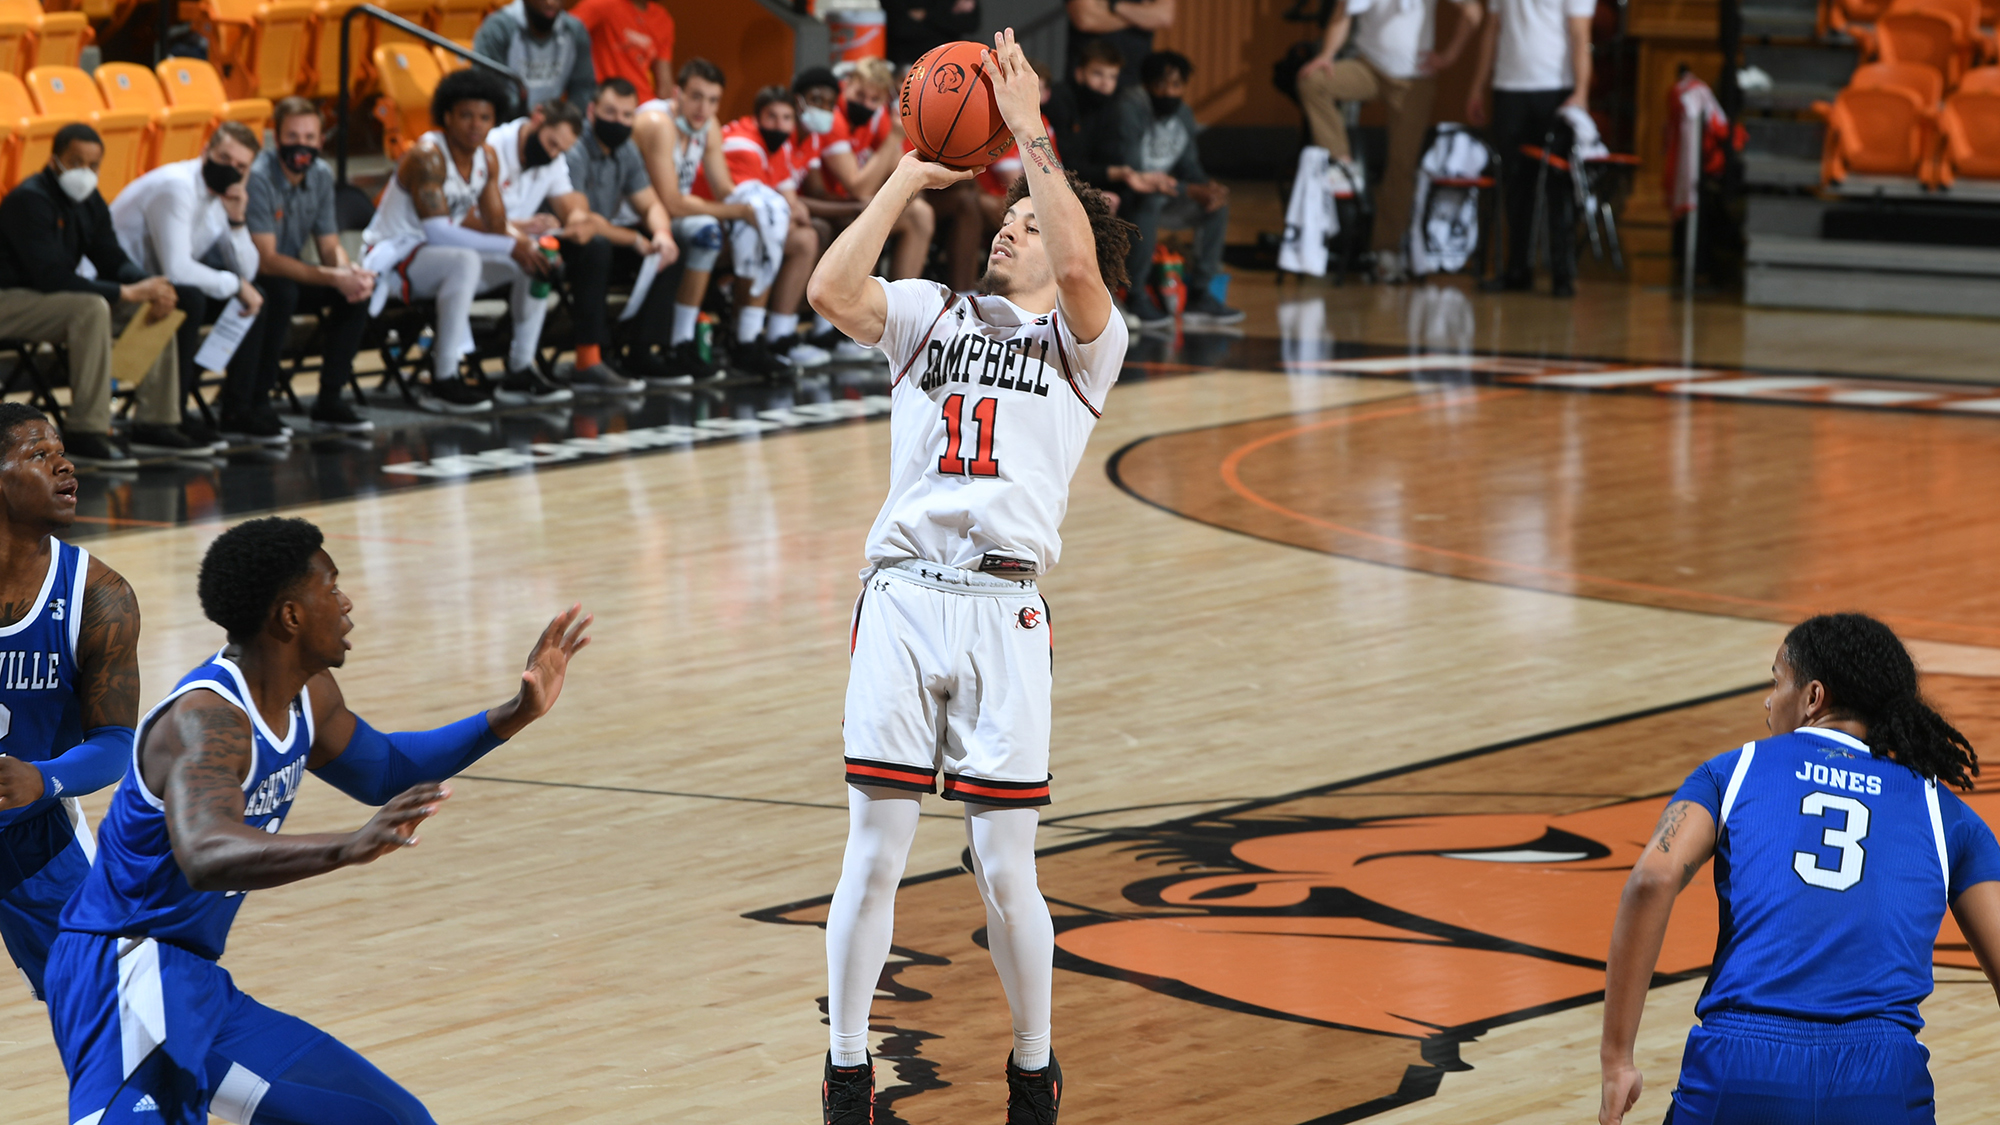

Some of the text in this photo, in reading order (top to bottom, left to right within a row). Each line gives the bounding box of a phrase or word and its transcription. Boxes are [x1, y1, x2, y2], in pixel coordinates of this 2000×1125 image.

[902, 49, 933, 117] ALDING
[1023, 141, 1044, 168] Noelle
[920, 333, 1049, 397] CAMPBELL
[938, 393, 999, 477] 11
[1796, 761, 1882, 796] JONES
[1792, 791, 1871, 892] 3
